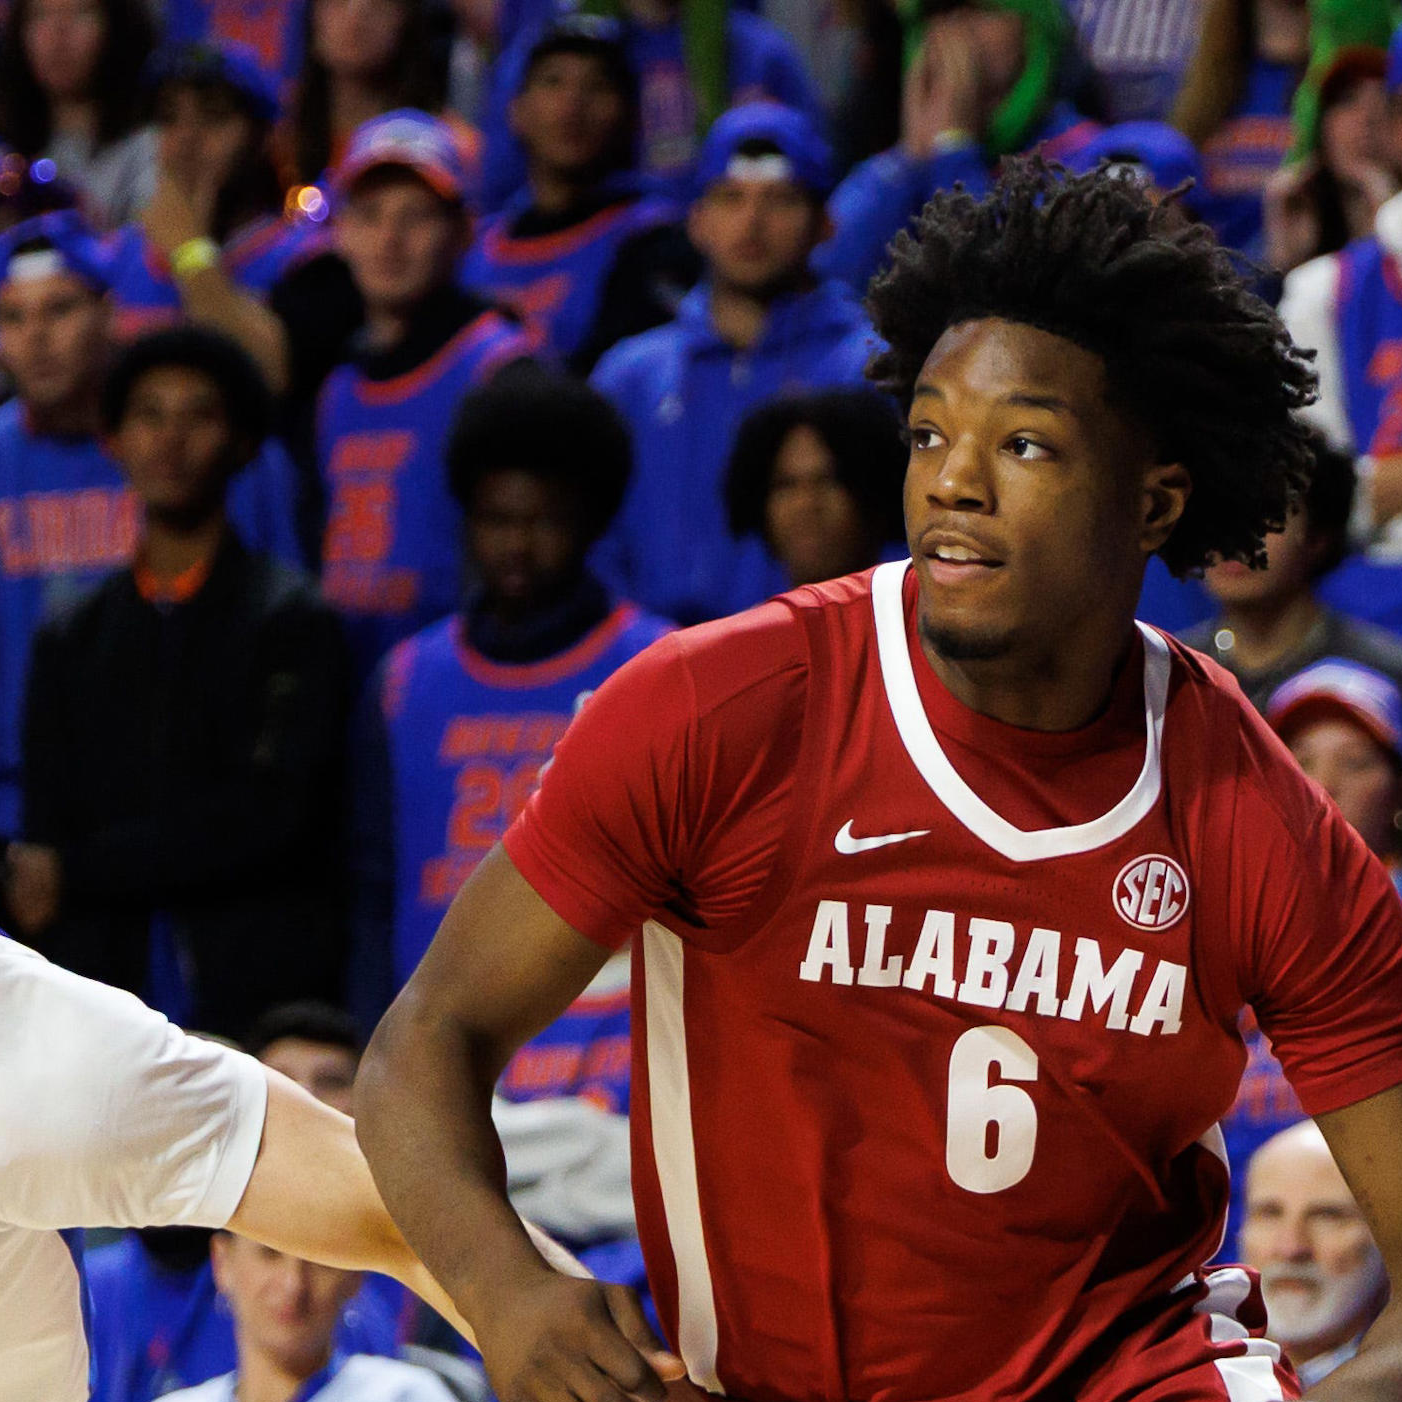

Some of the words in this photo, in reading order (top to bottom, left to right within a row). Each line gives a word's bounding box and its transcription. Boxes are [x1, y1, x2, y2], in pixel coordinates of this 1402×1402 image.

[1118, 861, 1184, 925] SEC
[799, 900, 1187, 1037] ALABAMA
[946, 1024, 1039, 1194] 6
